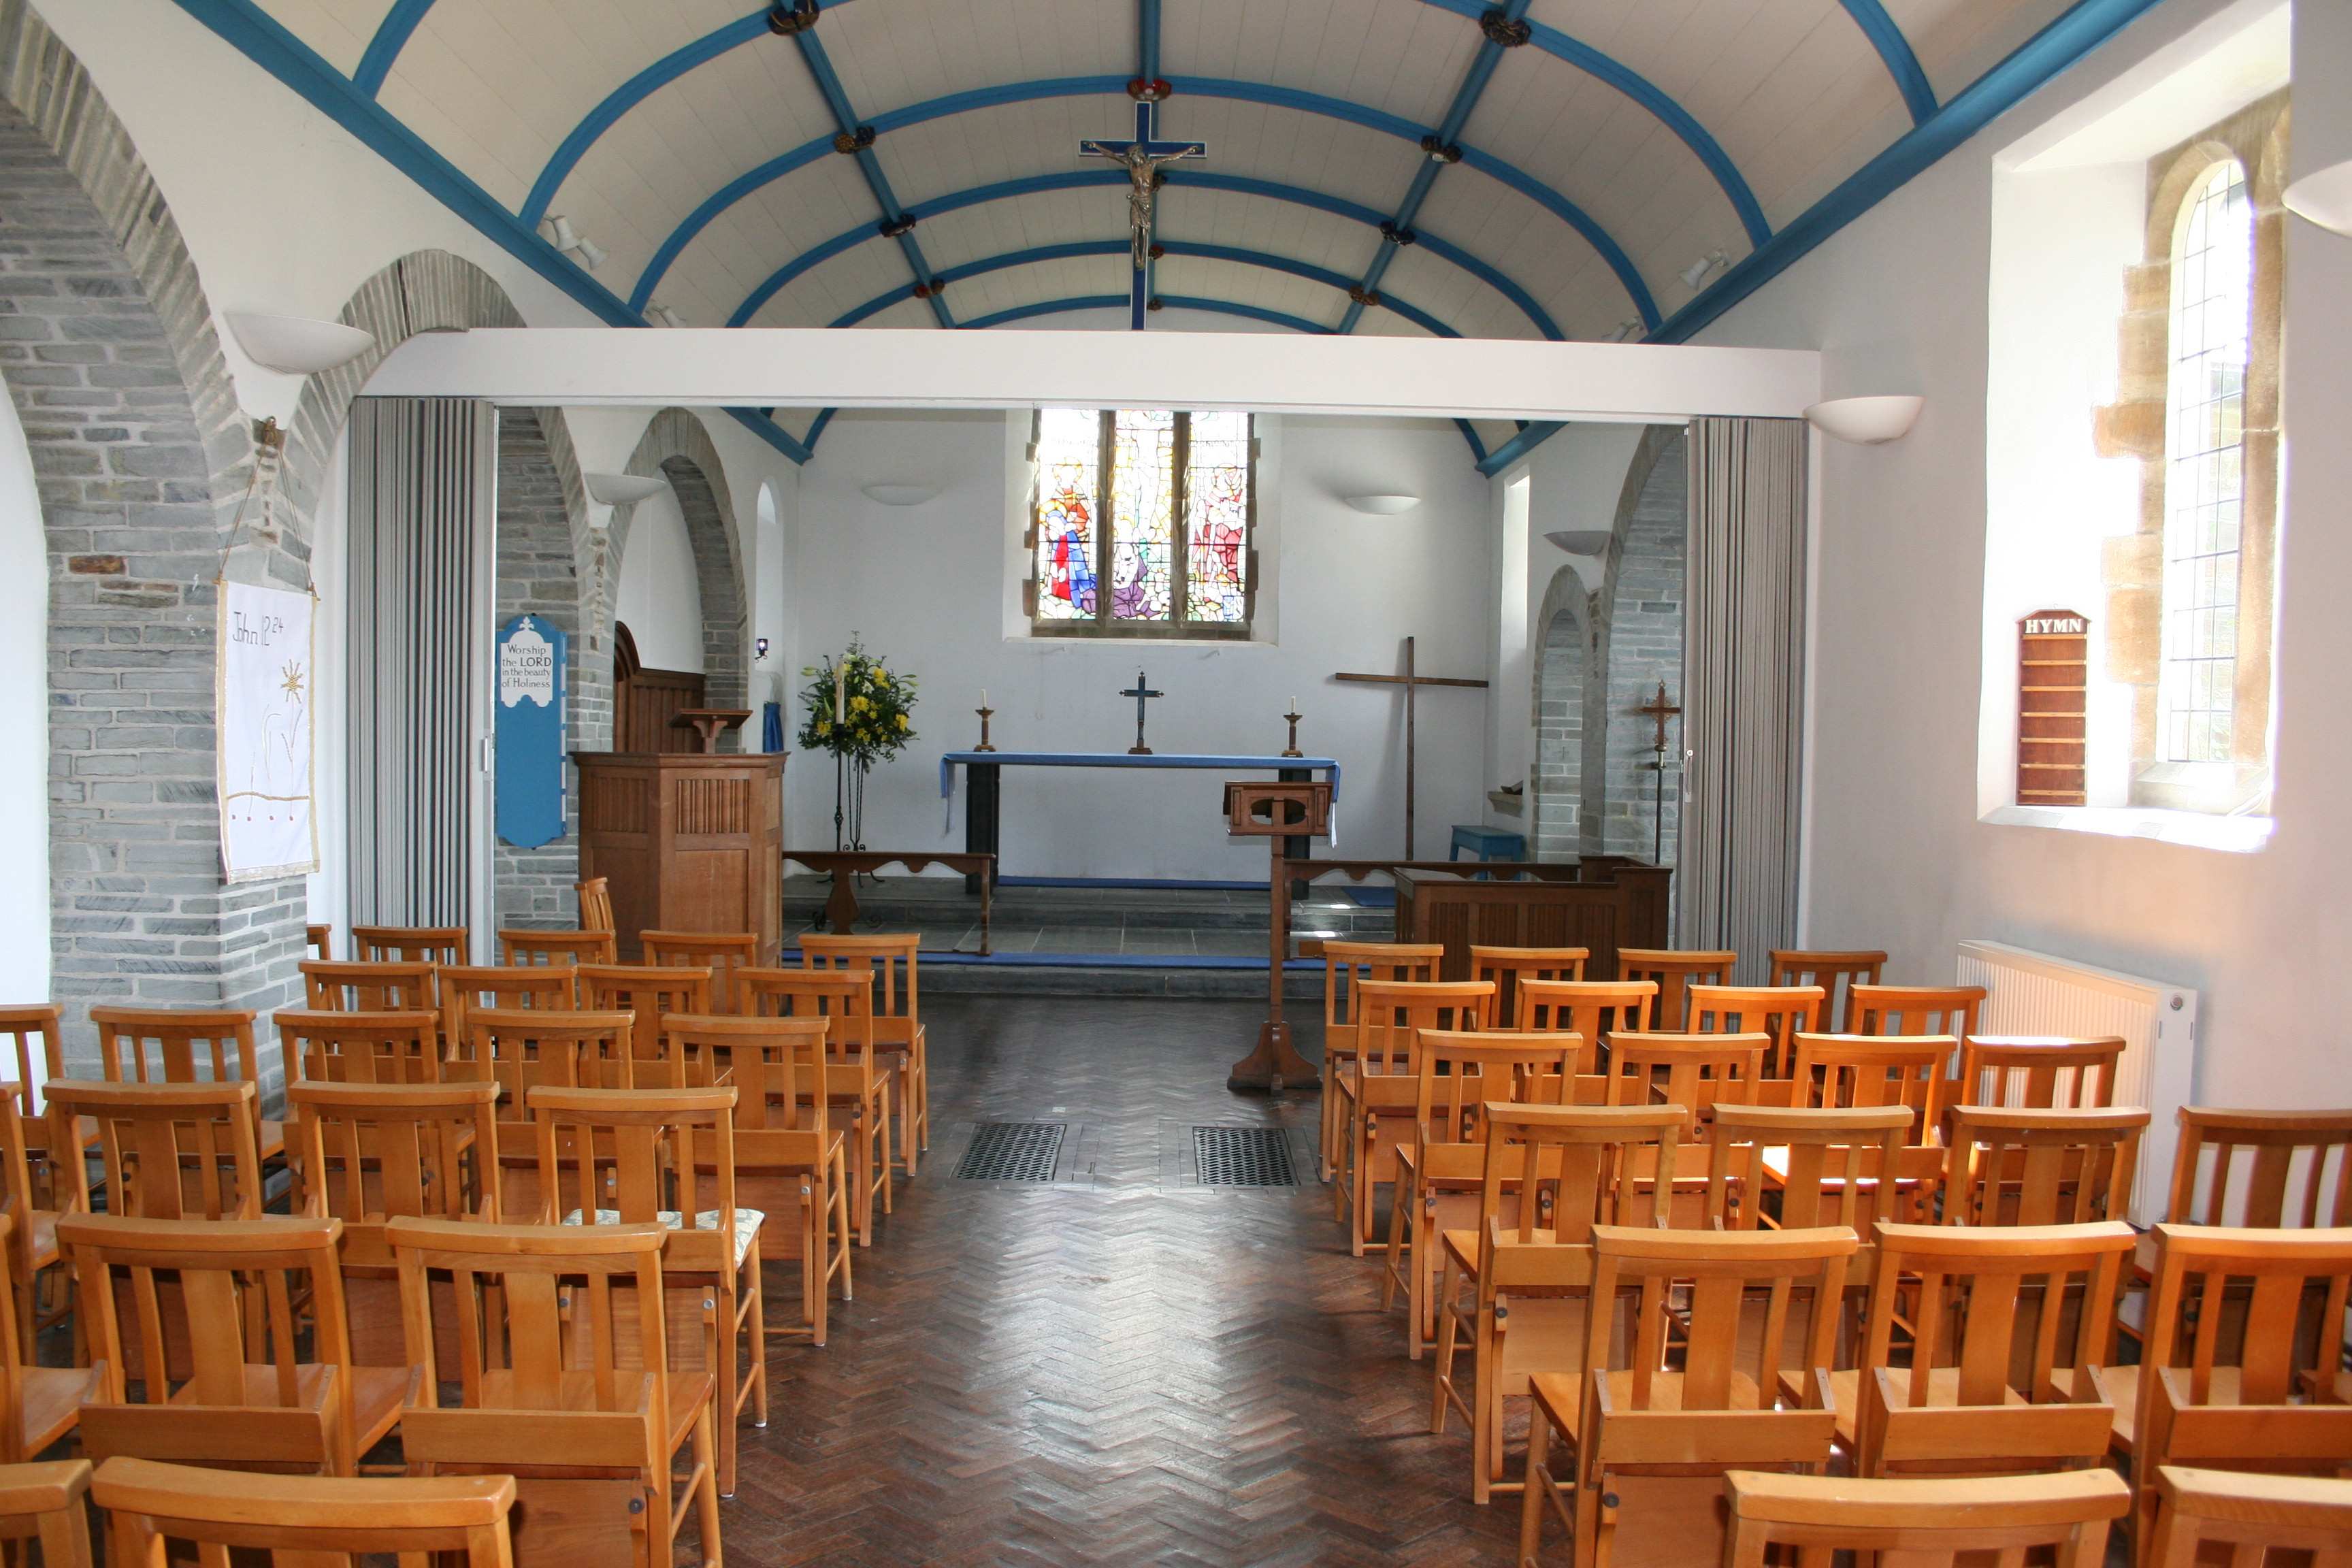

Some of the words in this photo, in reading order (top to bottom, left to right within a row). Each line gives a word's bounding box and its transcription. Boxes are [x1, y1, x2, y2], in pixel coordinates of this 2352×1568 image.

[233, 611, 259, 645] John
[2025, 619, 2082, 634] HYMN
[507, 644, 546, 657] Worship
[502, 657, 517, 667] the
[520, 657, 552, 667] LORD
[502, 667, 510, 676] in
[510, 667, 523, 676] the
[524, 667, 550, 679] beauty
[502, 677, 512, 687] of
[513, 677, 551, 687] Holiness
